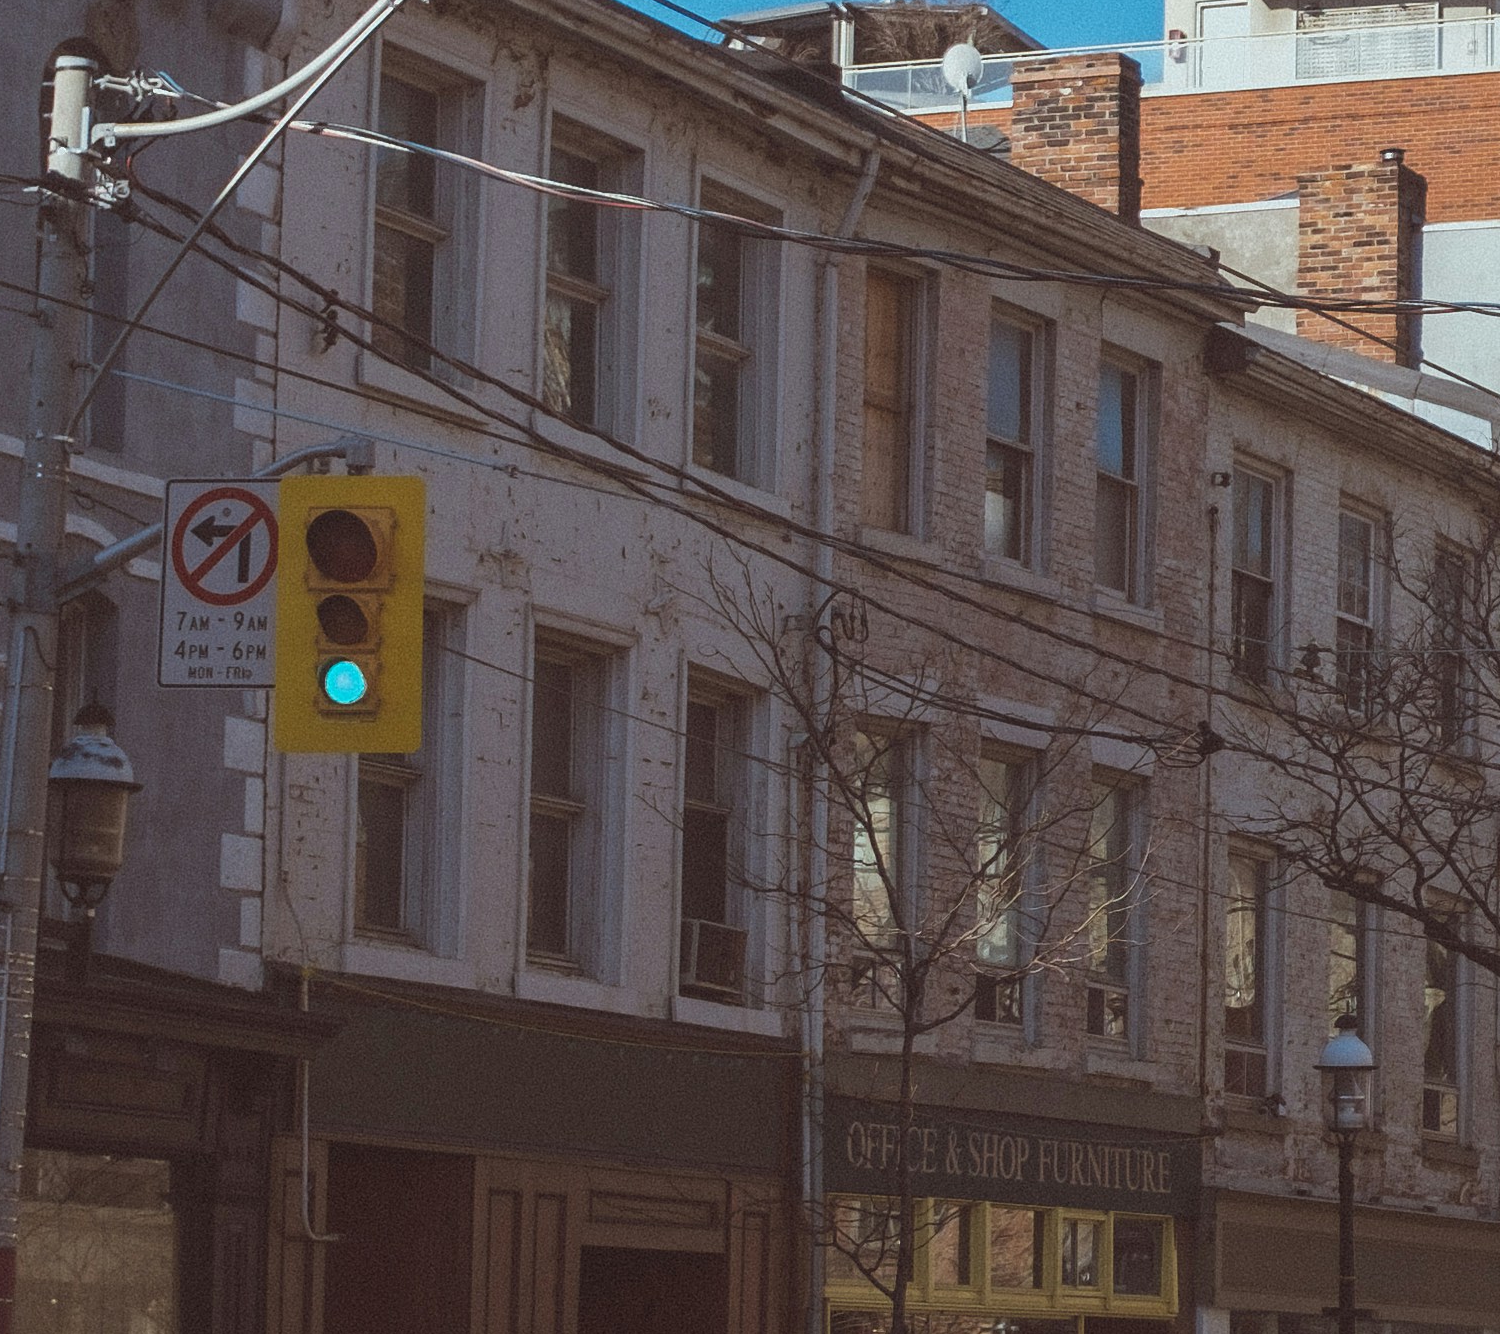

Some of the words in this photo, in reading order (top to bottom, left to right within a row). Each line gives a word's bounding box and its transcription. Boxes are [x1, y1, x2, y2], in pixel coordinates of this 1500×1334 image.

[846, 1120, 938, 1174] OFFICE
[945, 1129, 963, 1176] &
[967, 1131, 1031, 1182] SHOP
[1038, 1138, 1173, 1194] FURNITURE
